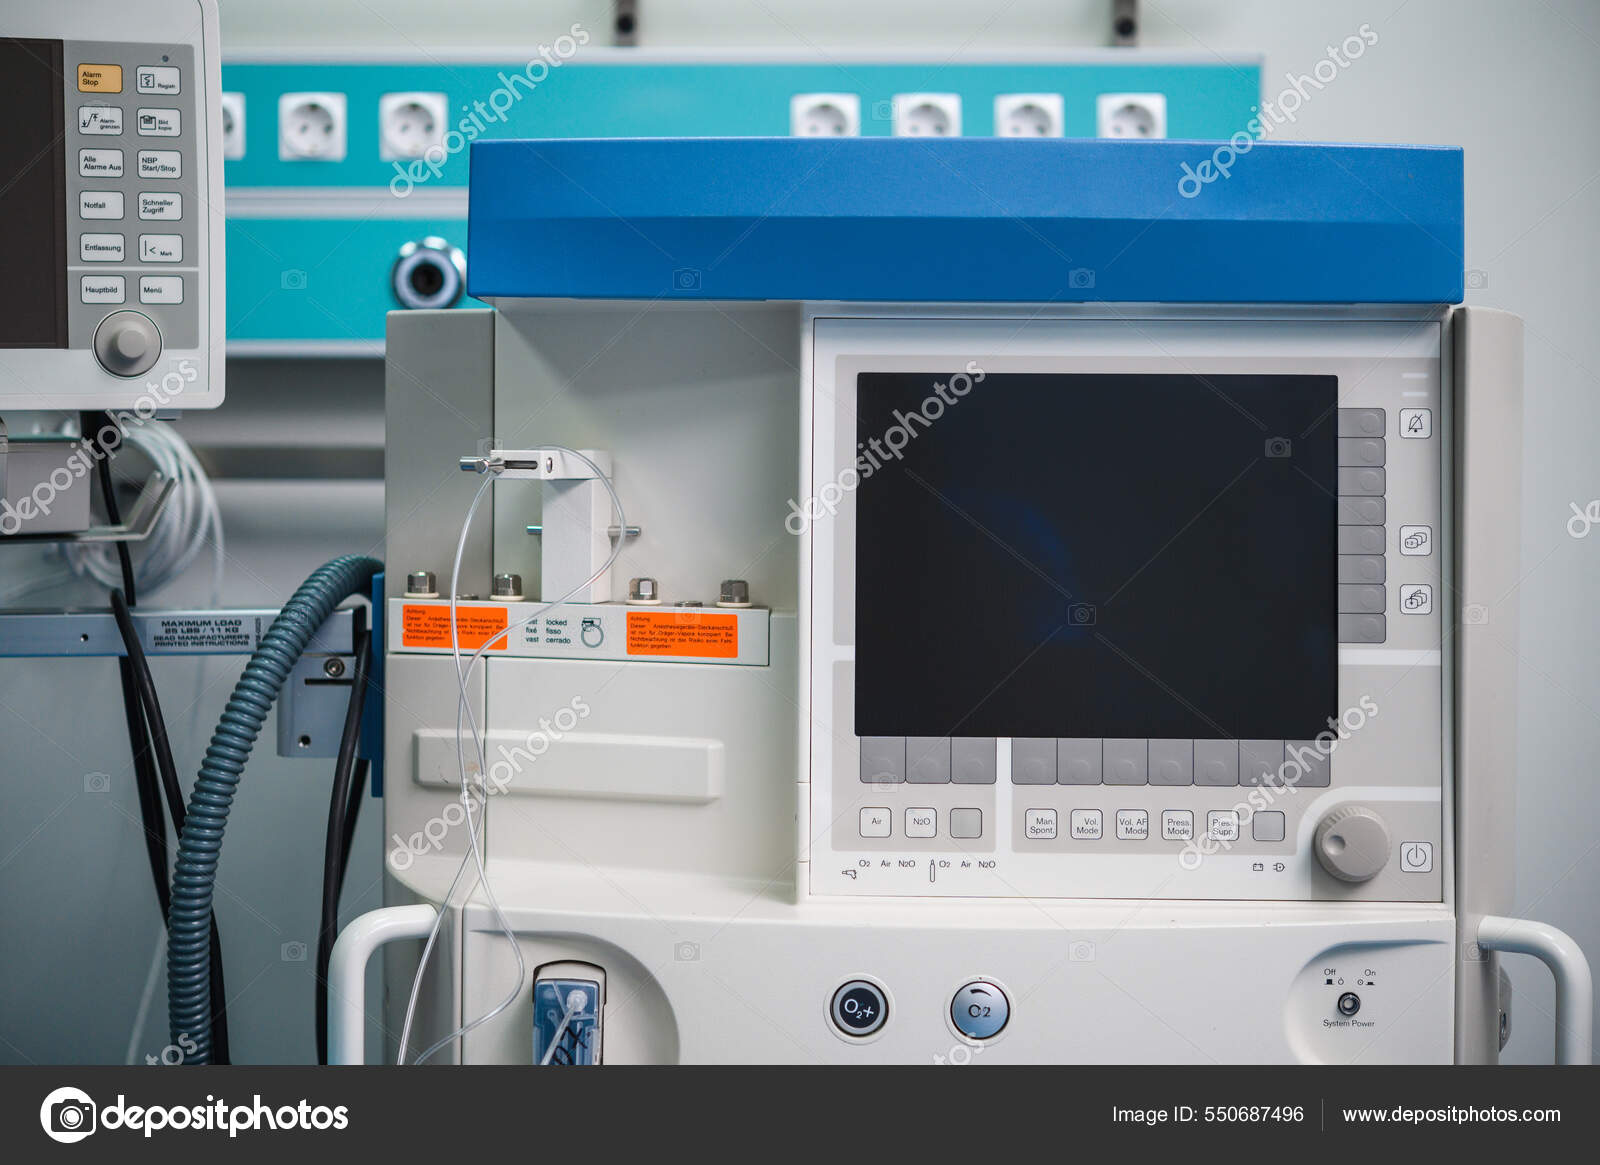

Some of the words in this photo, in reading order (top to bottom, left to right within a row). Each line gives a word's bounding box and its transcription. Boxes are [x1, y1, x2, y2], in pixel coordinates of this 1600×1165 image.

[84, 244, 121, 252] Entlassung
[1030, 827, 1055, 836] Spont.
[1076, 827, 1099, 835] Mode
[968, 1005, 990, 1018] O2
[1323, 1020, 1350, 1028] System
